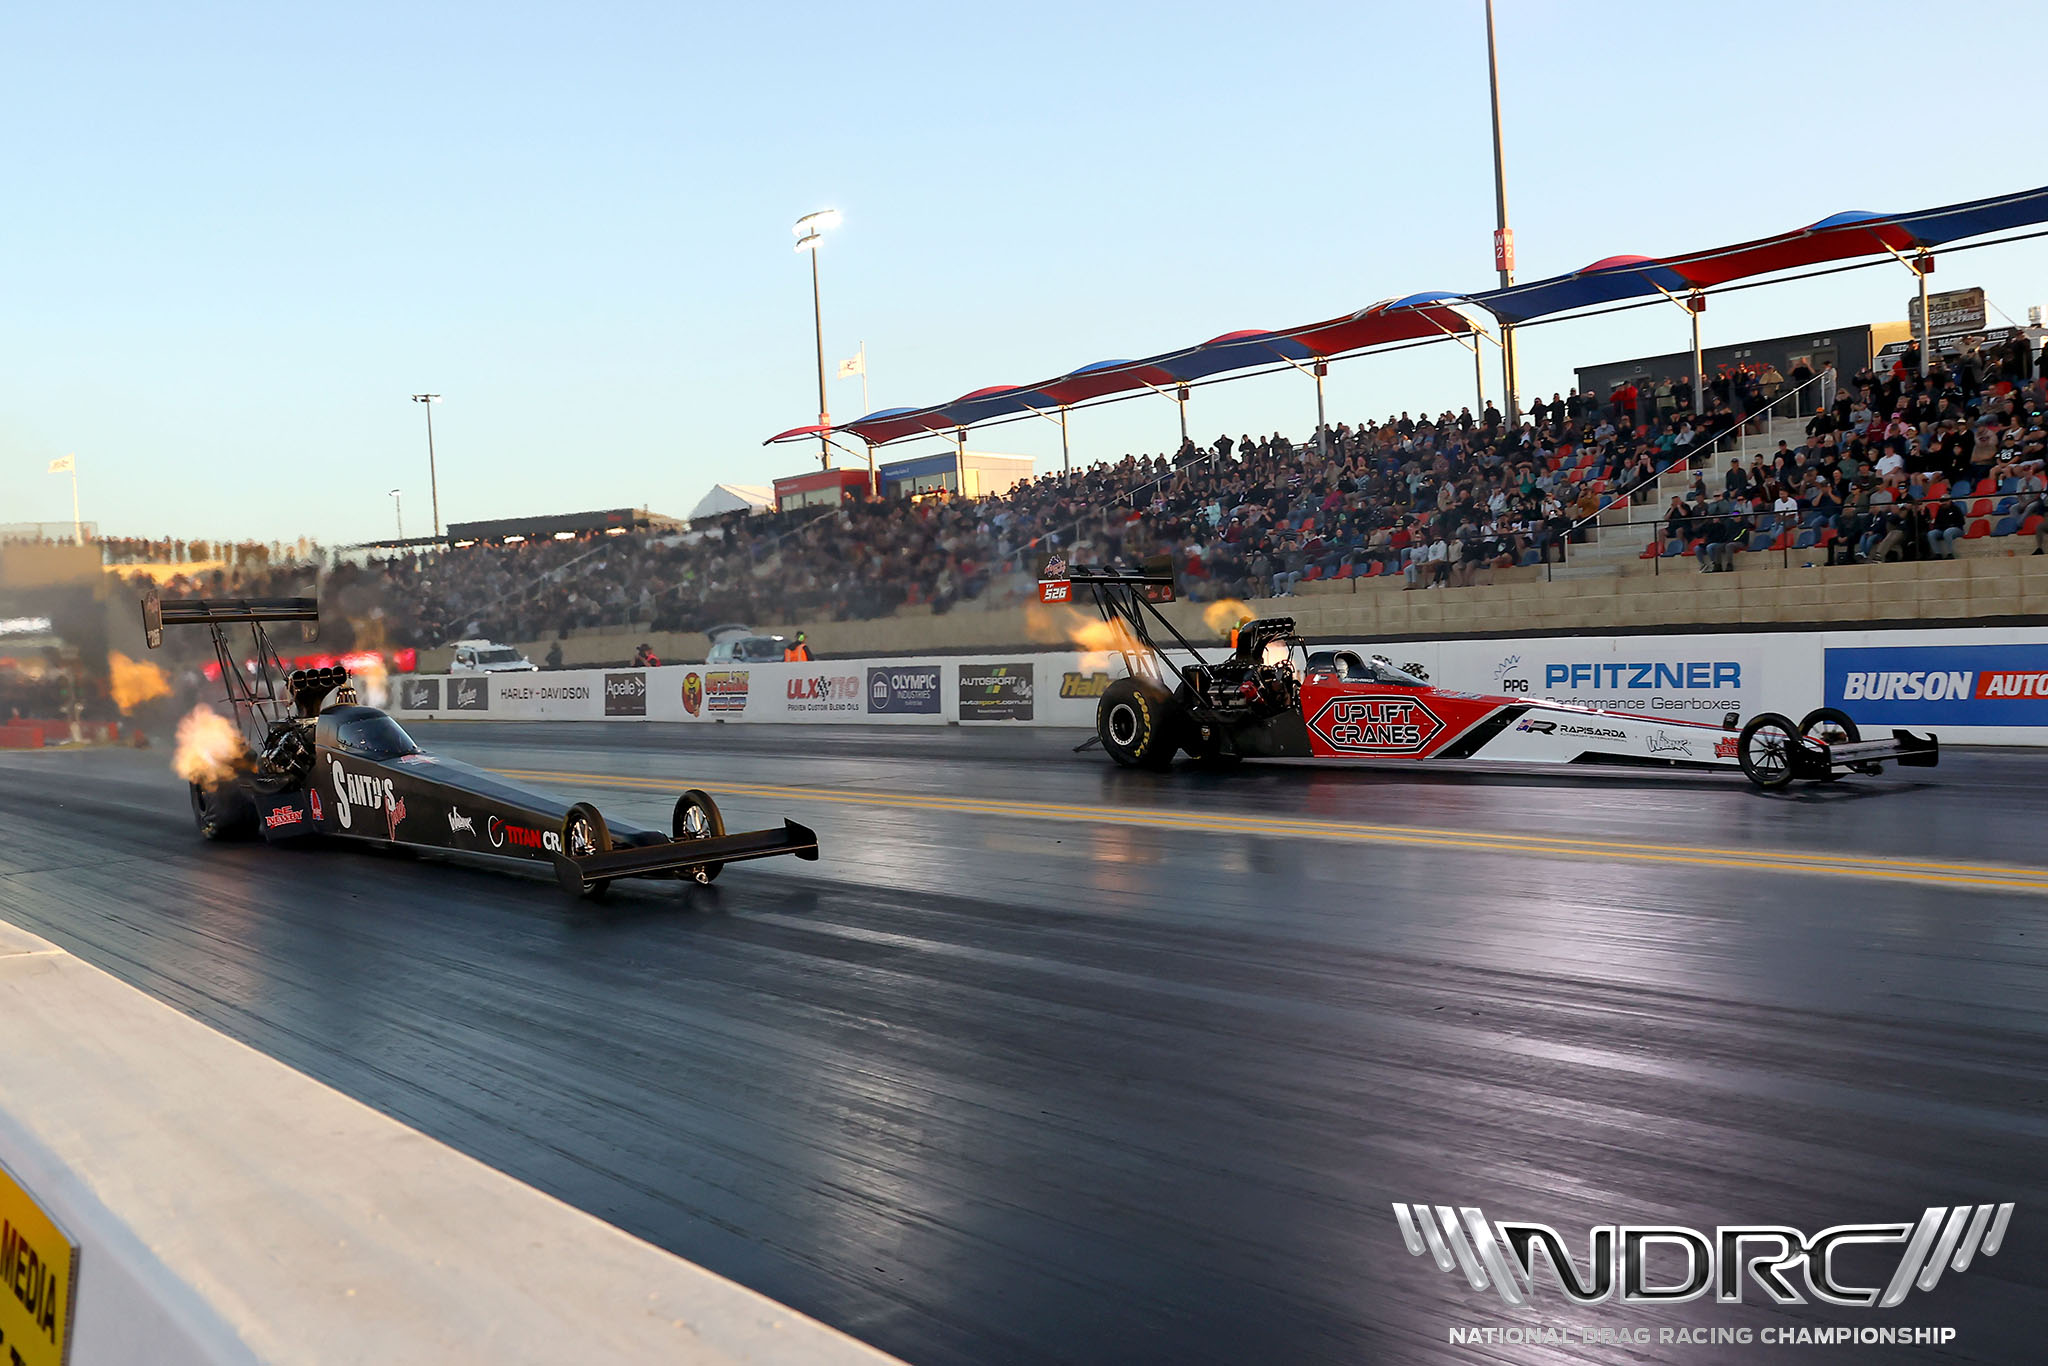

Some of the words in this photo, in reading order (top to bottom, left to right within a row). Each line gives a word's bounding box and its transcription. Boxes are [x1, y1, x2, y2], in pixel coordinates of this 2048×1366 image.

[1045, 587, 1067, 600] 526
[892, 674, 936, 690] OLYMPIC
[960, 676, 1017, 686] AUTOSPORT
[1545, 662, 1741, 689] PFITZNER
[1504, 679, 1529, 692] PPG
[1843, 672, 1973, 700] BURSON
[1985, 673, 2048, 696] AUTO
[1651, 697, 1741, 710] Gearboxes
[1333, 703, 1416, 724] UPLIFT
[1331, 724, 1421, 745] CRANES
[1560, 725, 1627, 738] RAPISARDA
[504, 825, 542, 849] TITAN
[542, 831, 562, 852] CR
[0, 1219, 56, 1346] MEDIA
